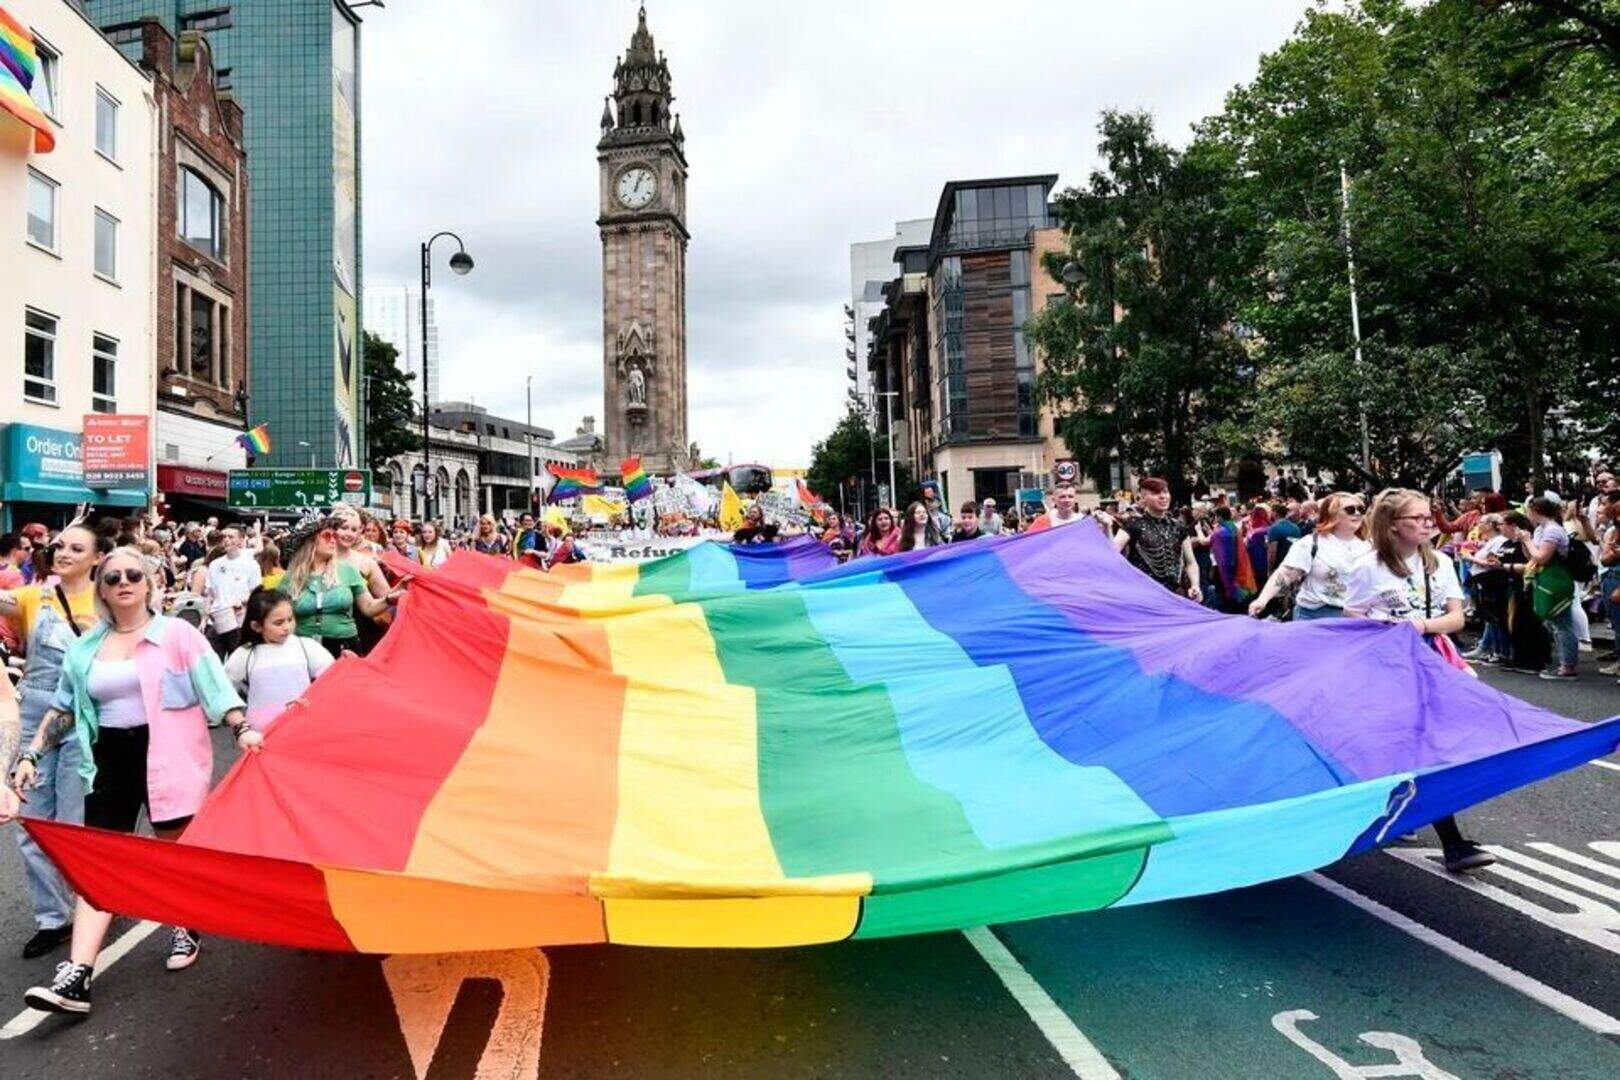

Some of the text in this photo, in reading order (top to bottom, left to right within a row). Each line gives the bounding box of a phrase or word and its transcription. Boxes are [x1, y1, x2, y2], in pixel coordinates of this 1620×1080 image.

[26, 435, 63, 456] Order
[86, 434, 131, 444] TO LET
